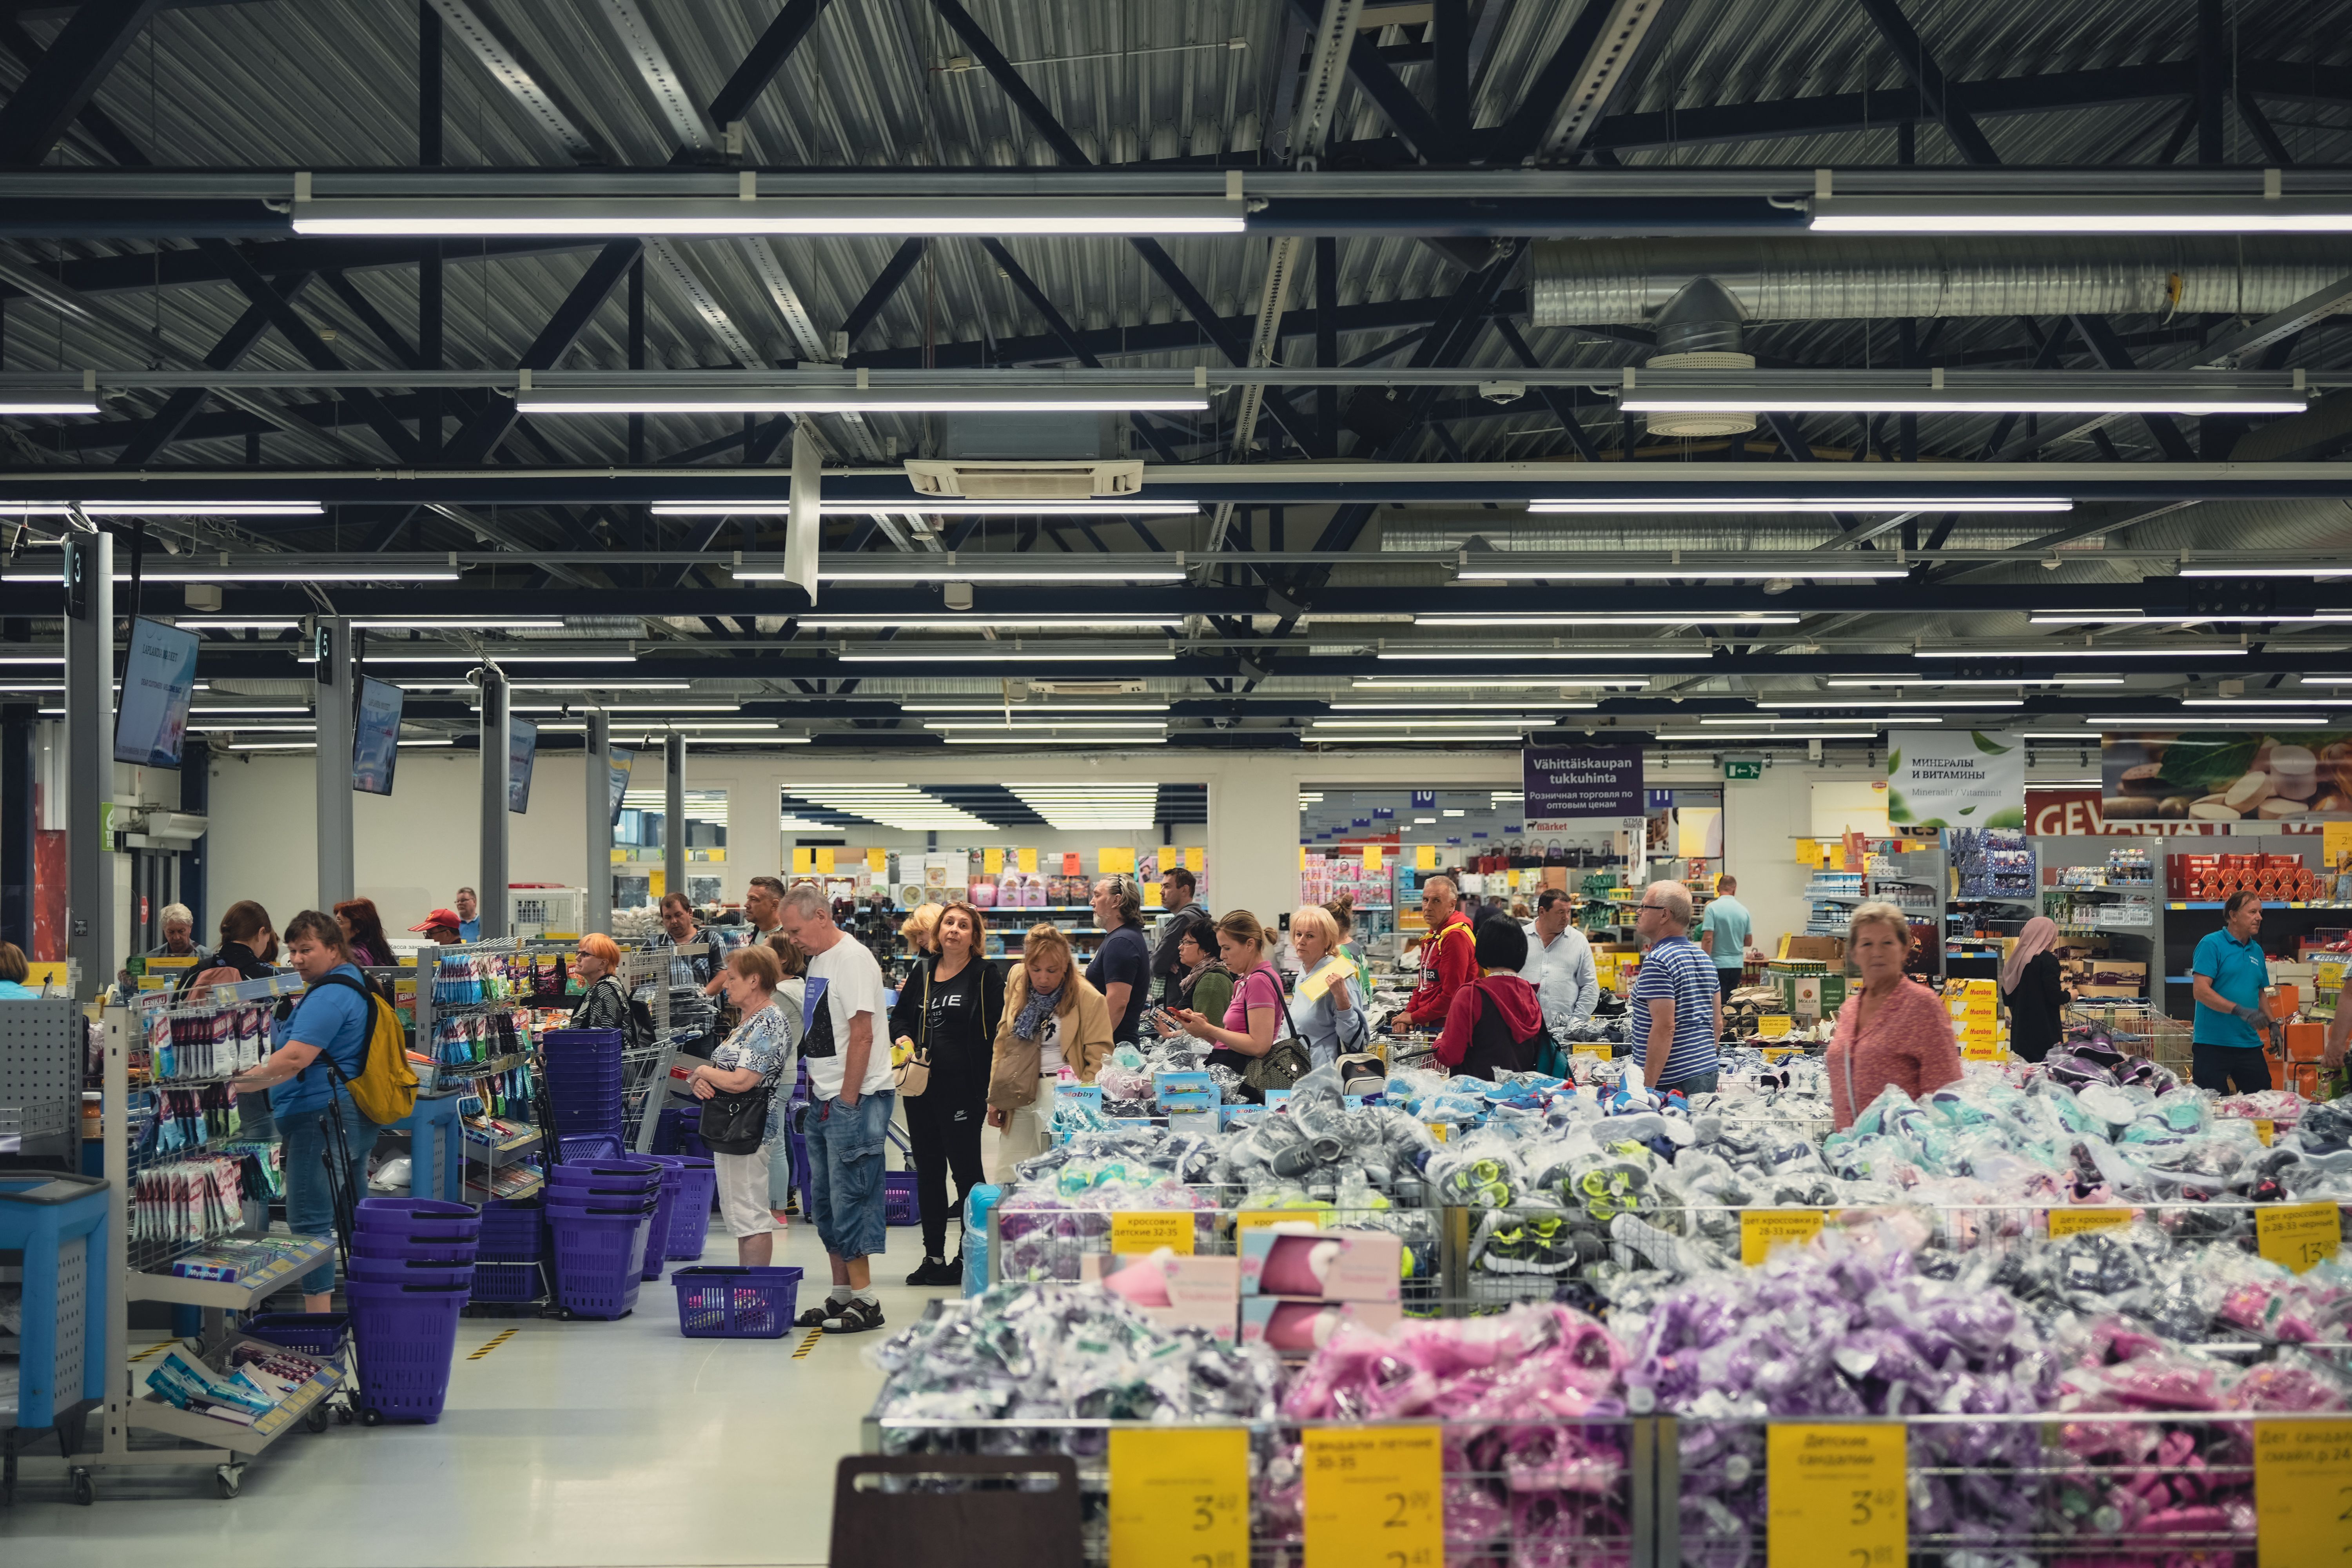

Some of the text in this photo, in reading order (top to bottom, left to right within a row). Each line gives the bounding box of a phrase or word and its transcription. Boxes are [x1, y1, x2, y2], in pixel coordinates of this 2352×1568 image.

[74, 552, 81, 583] 3
[323, 634, 328, 656] 5
[163, 650, 178, 662] MARKET
[1534, 757, 1632, 770] Vähittäiskaupan
[1912, 759, 1974, 768] МИНЕРАЛЫ
[1550, 772, 1617, 784] tukkuhinta
[1912, 771, 1985, 779] И ВИТАМИНЫ
[1529, 791, 1577, 800] Розничная
[1579, 791, 1620, 800] торговля
[1912, 788, 1953, 796] Mineraalit
[1961, 788, 2002, 797] Vitamiinit
[1588, 801, 1617, 809] ценам
[1537, 822, 1567, 831] market
[143, 996, 167, 1006] JENKKI
[1128, 1218, 1176, 1227] кроссовки
[1759, 1227, 1807, 1236] 28-33 хаки
[2298, 1242, 2323, 1263] 13
[188, 1269, 220, 1278] Mynthon
[156, 1379, 183, 1403] Mynthon
[1193, 1495, 1215, 1531] 3
[1382, 1493, 1408, 1528] 2
[1850, 1490, 1873, 1525] 3
